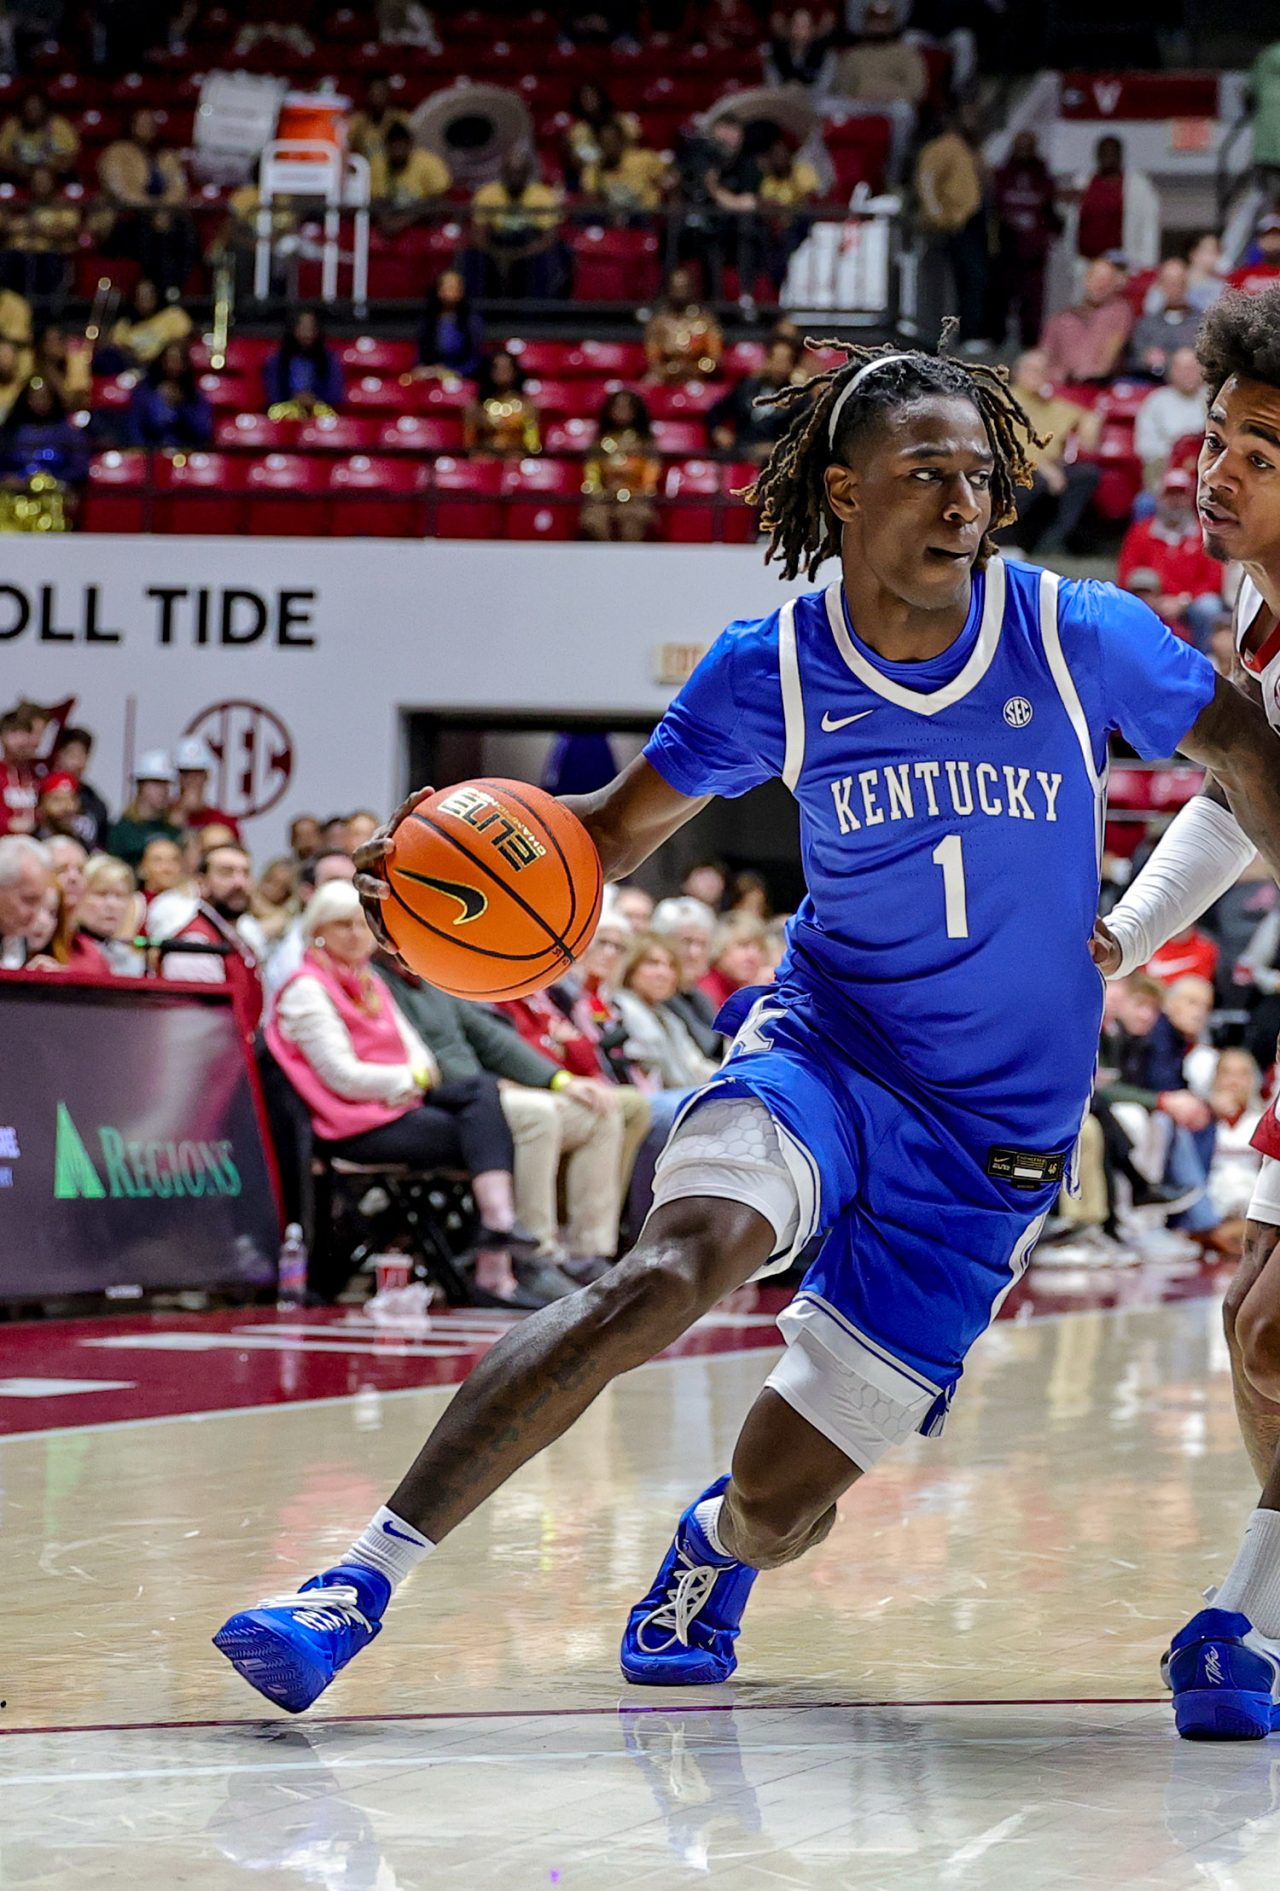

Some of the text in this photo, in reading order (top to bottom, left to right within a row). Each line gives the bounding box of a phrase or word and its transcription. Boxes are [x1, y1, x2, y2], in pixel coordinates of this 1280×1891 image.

[146, 587, 316, 646] TIDE
[1004, 697, 1032, 727] SEC
[437, 786, 539, 873] ELITE
[830, 760, 1063, 835] KENTUCKY
[932, 834, 969, 939] 1
[97, 1125, 243, 1199] REGIONS
